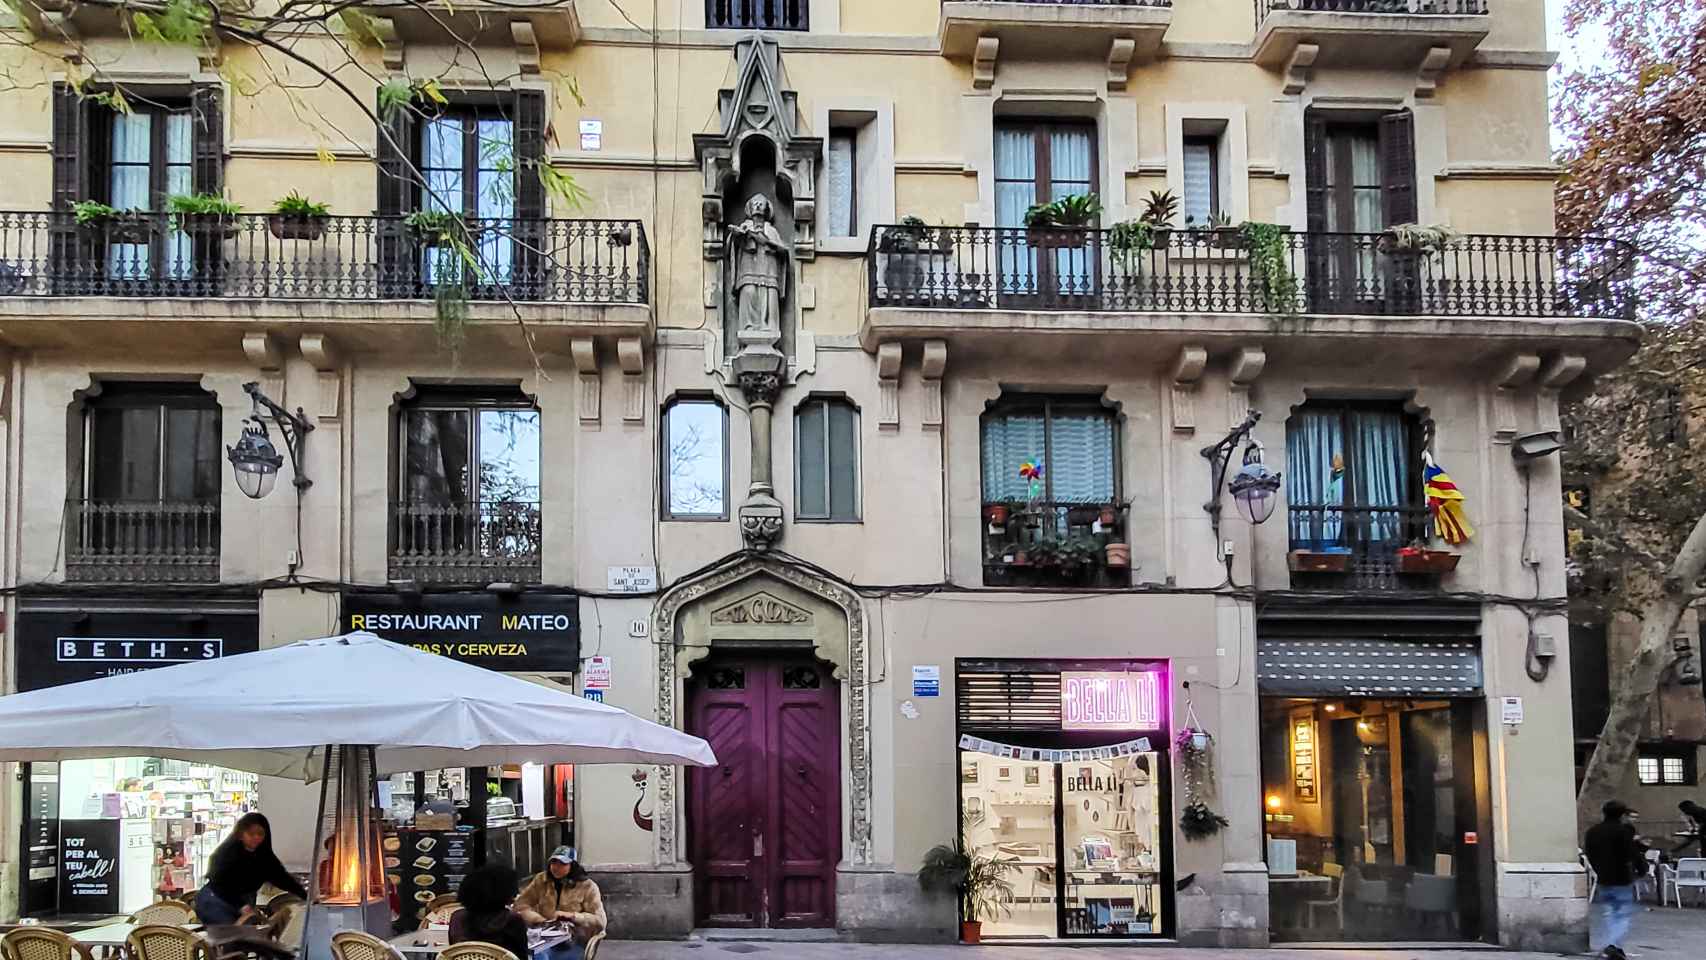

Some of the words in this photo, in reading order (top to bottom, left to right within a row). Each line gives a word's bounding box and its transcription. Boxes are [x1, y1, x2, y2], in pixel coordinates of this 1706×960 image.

[351, 614, 482, 630] RESTAURANT
[502, 614, 569, 630] MATEO
[633, 622, 644, 632] 10
[444, 644, 455, 656] Y
[458, 644, 528, 656] CERVEZA
[1067, 678, 1130, 722] BELLA
[1068, 776, 1103, 792] BELLA
[65, 838, 85, 847] TOT
[65, 850, 85, 859] PER
[86, 850, 100, 859] AL
[65, 861, 83, 870] TEU
